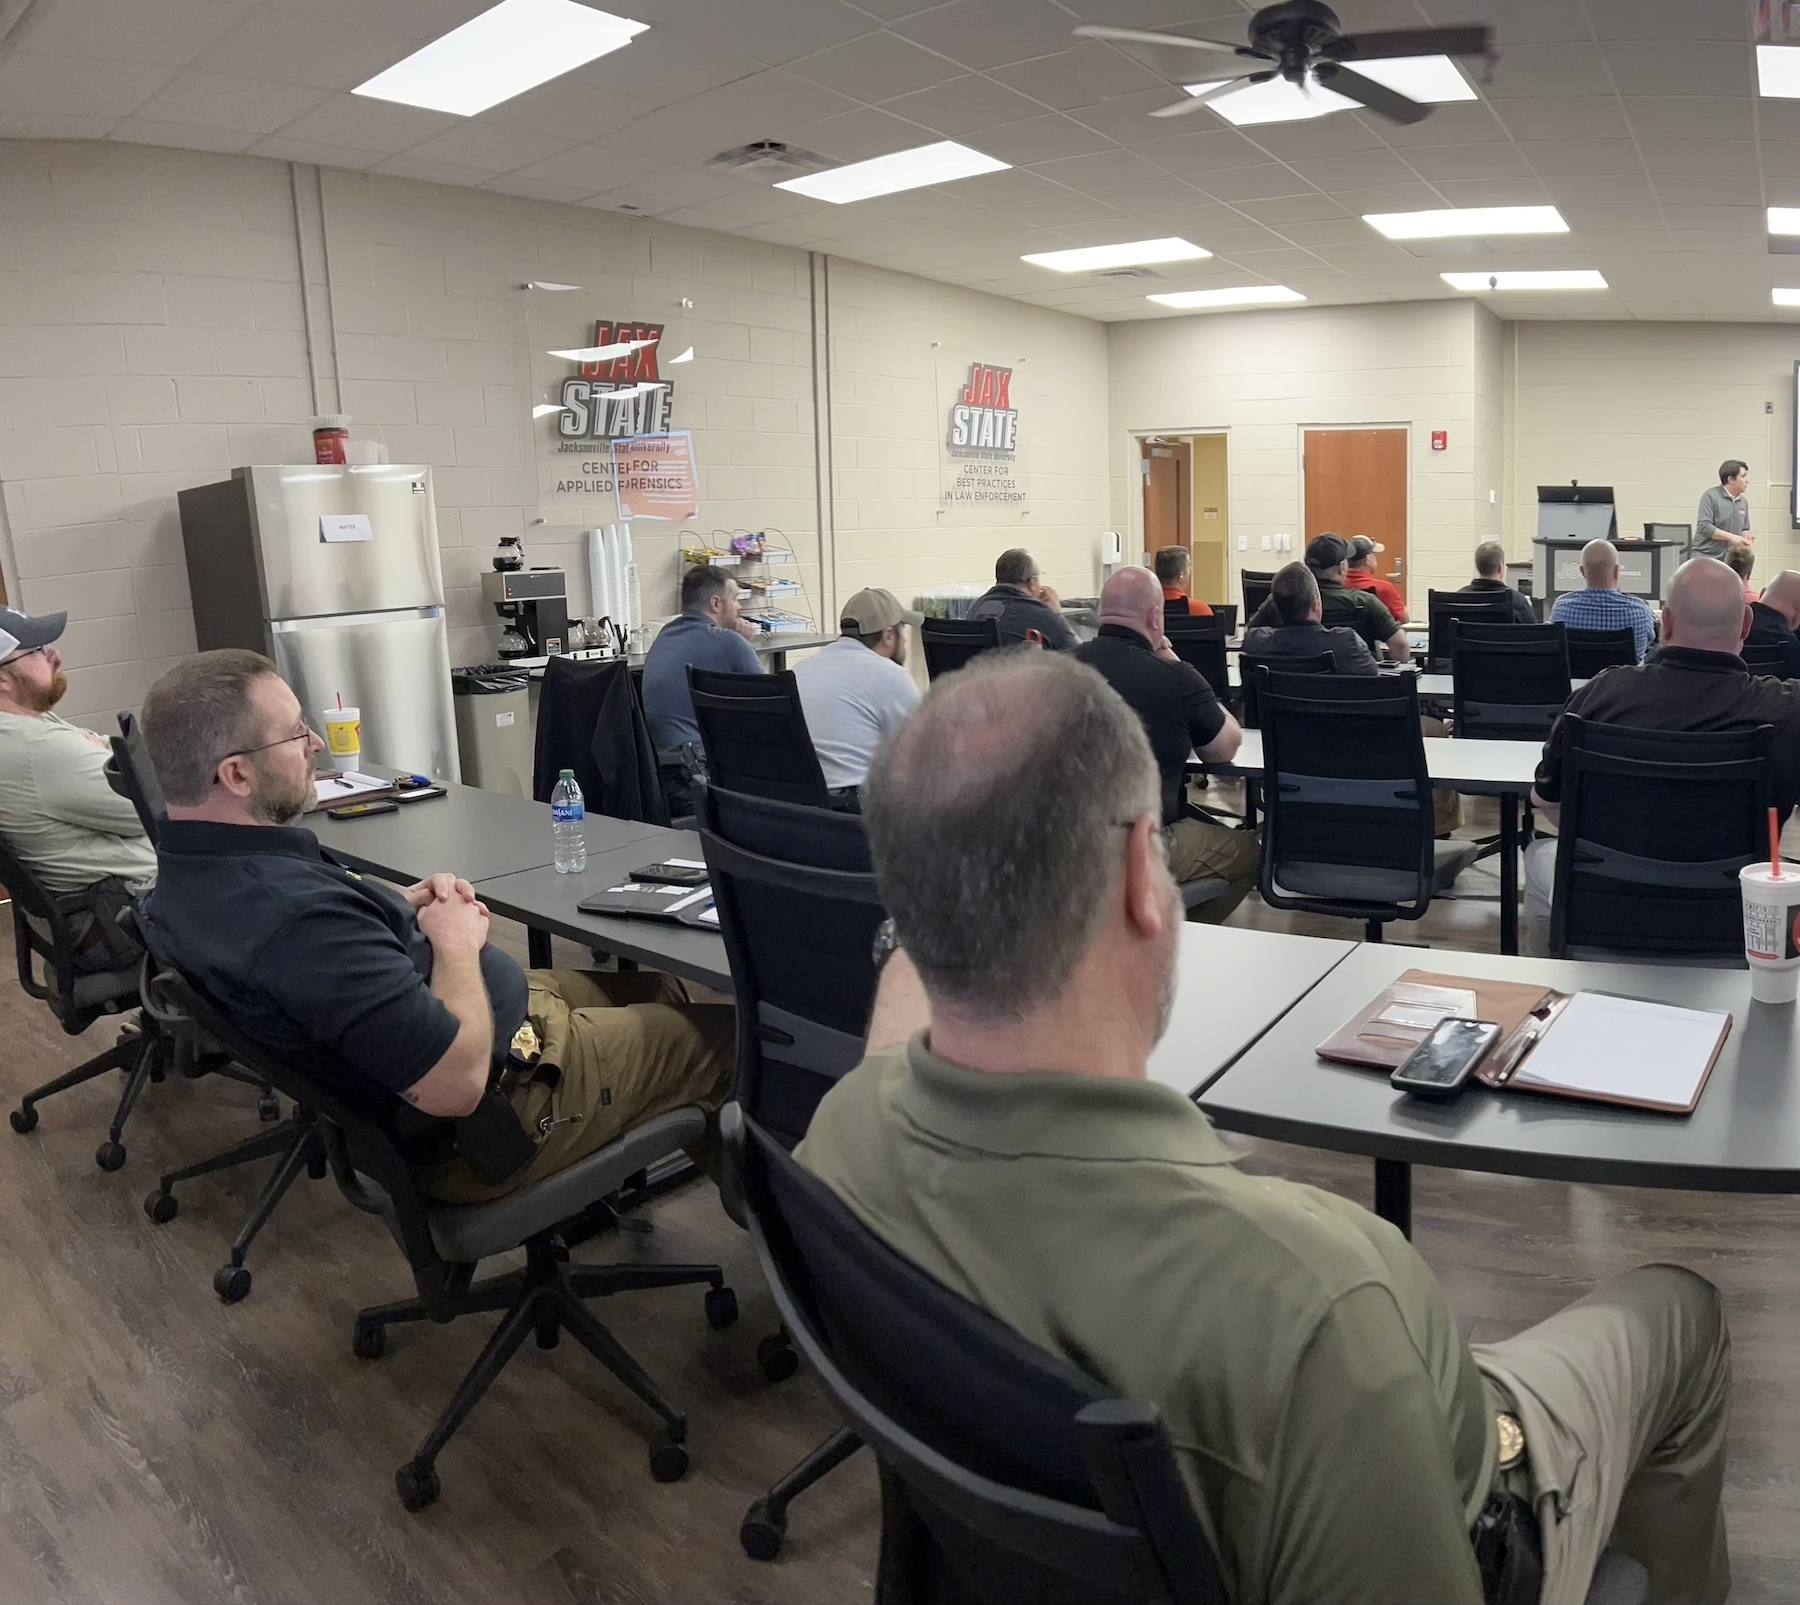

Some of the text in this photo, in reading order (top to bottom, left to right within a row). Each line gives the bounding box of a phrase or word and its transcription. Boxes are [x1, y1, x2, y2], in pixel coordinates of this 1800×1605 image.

[579, 320, 664, 381] JAX
[963, 362, 1013, 409] JAX
[558, 377, 674, 439] STATE
[952, 404, 1018, 451] STATE
[557, 441, 609, 455] Jacksonville
[614, 442, 632, 455] Stat
[633, 460, 658, 473] FOR
[964, 464, 1009, 476] CENTER FOR
[557, 480, 613, 493] APPLIED
[957, 477, 1016, 489] BEST PRACTICES
[945, 491, 1026, 501] IN LAW ENFORCEMENT
[1557, 563, 1583, 580] JS
